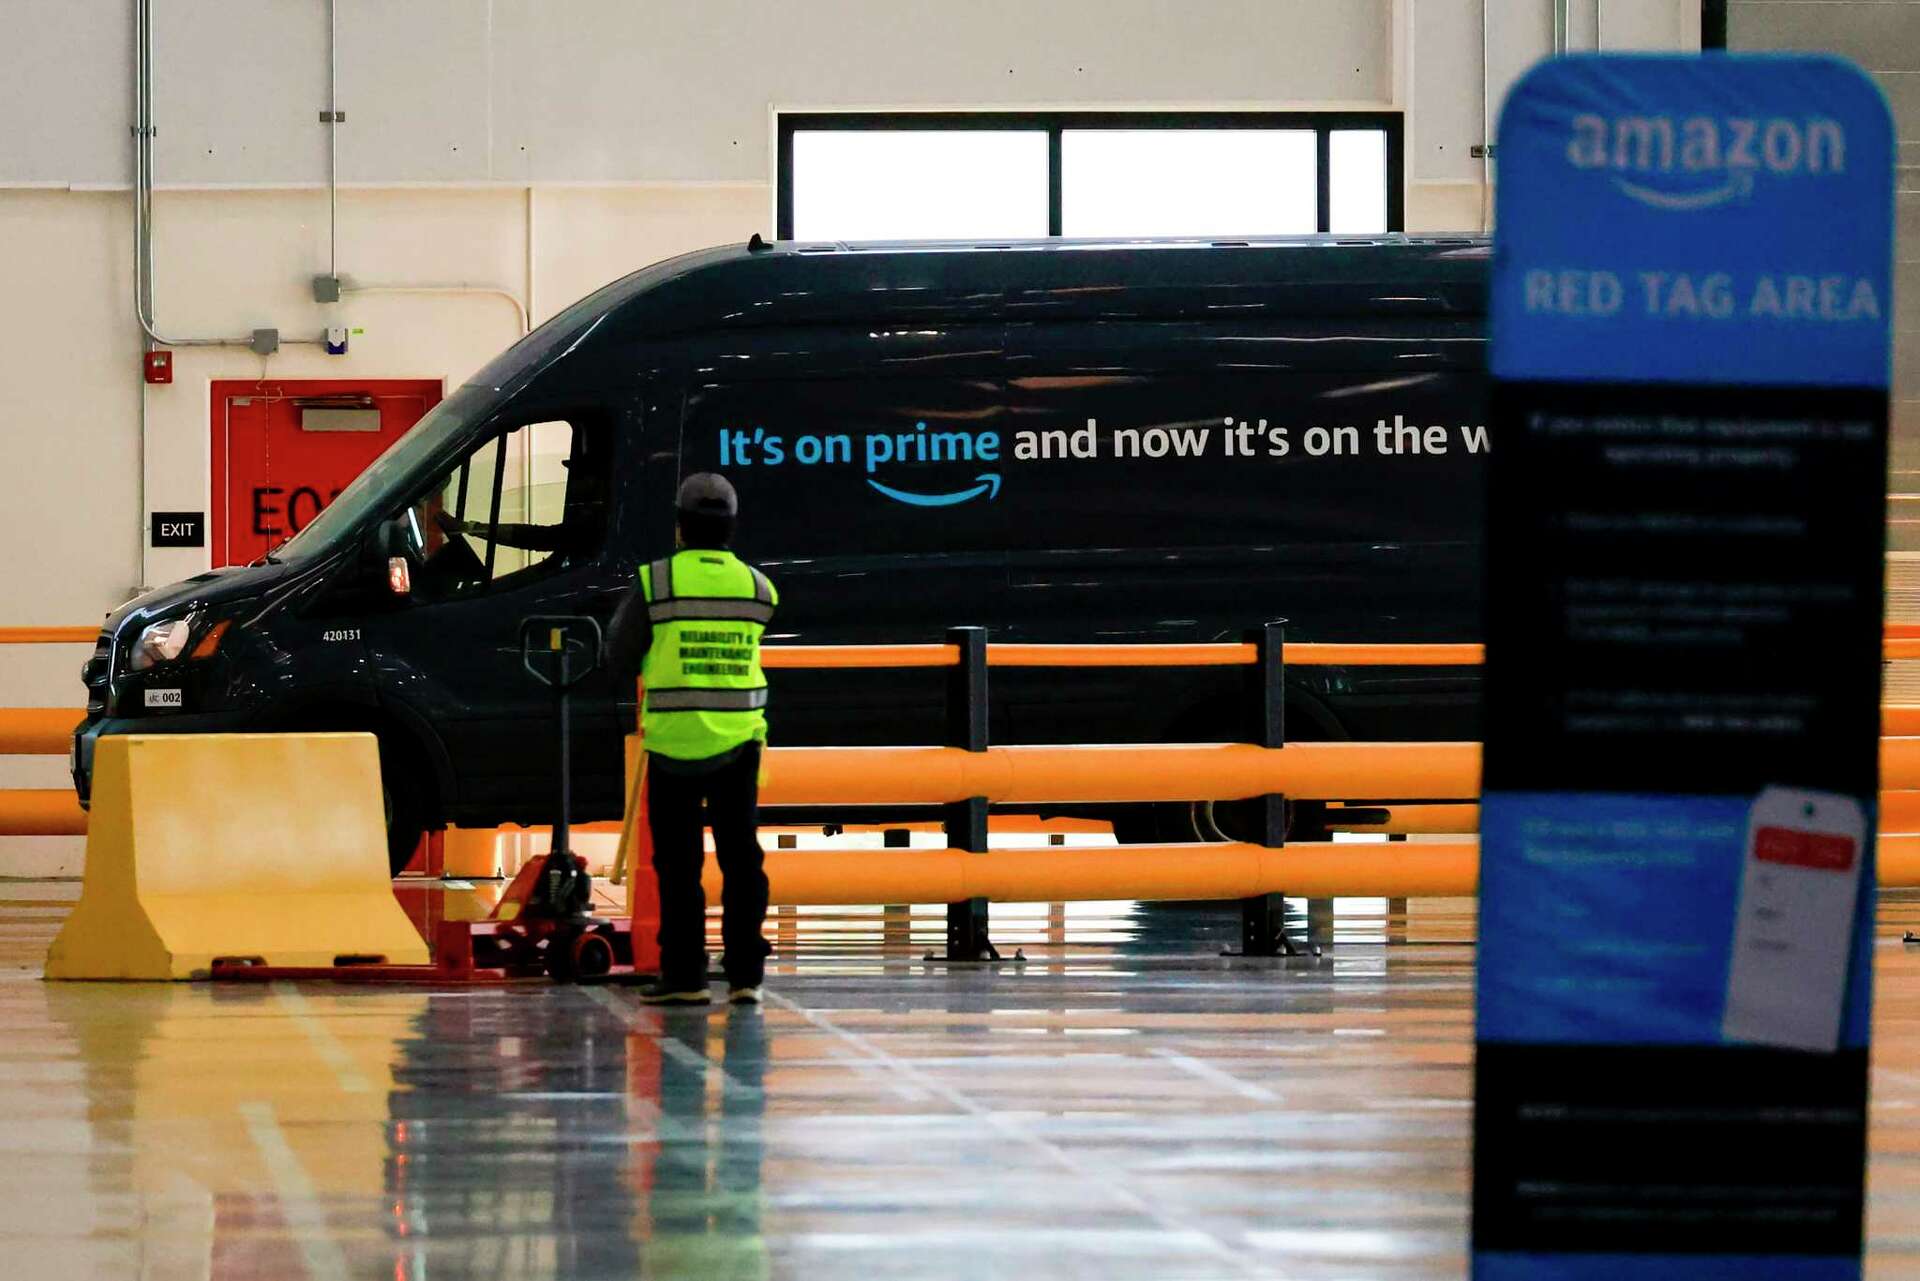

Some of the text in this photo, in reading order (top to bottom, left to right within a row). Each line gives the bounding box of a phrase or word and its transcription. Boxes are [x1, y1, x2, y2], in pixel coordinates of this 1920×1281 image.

[1567, 113, 1846, 173] amazon
[1524, 270, 1881, 321] RED TAG AREA
[795, 434, 852, 465] on
[865, 422, 1000, 473] prime
[1014, 418, 1097, 460] and
[1114, 428, 1210, 459] now
[1303, 426, 1360, 457] on
[1373, 414, 1448, 456] the
[161, 523, 195, 537] EXIT
[322, 629, 362, 642] 420131
[162, 692, 181, 703] 002
